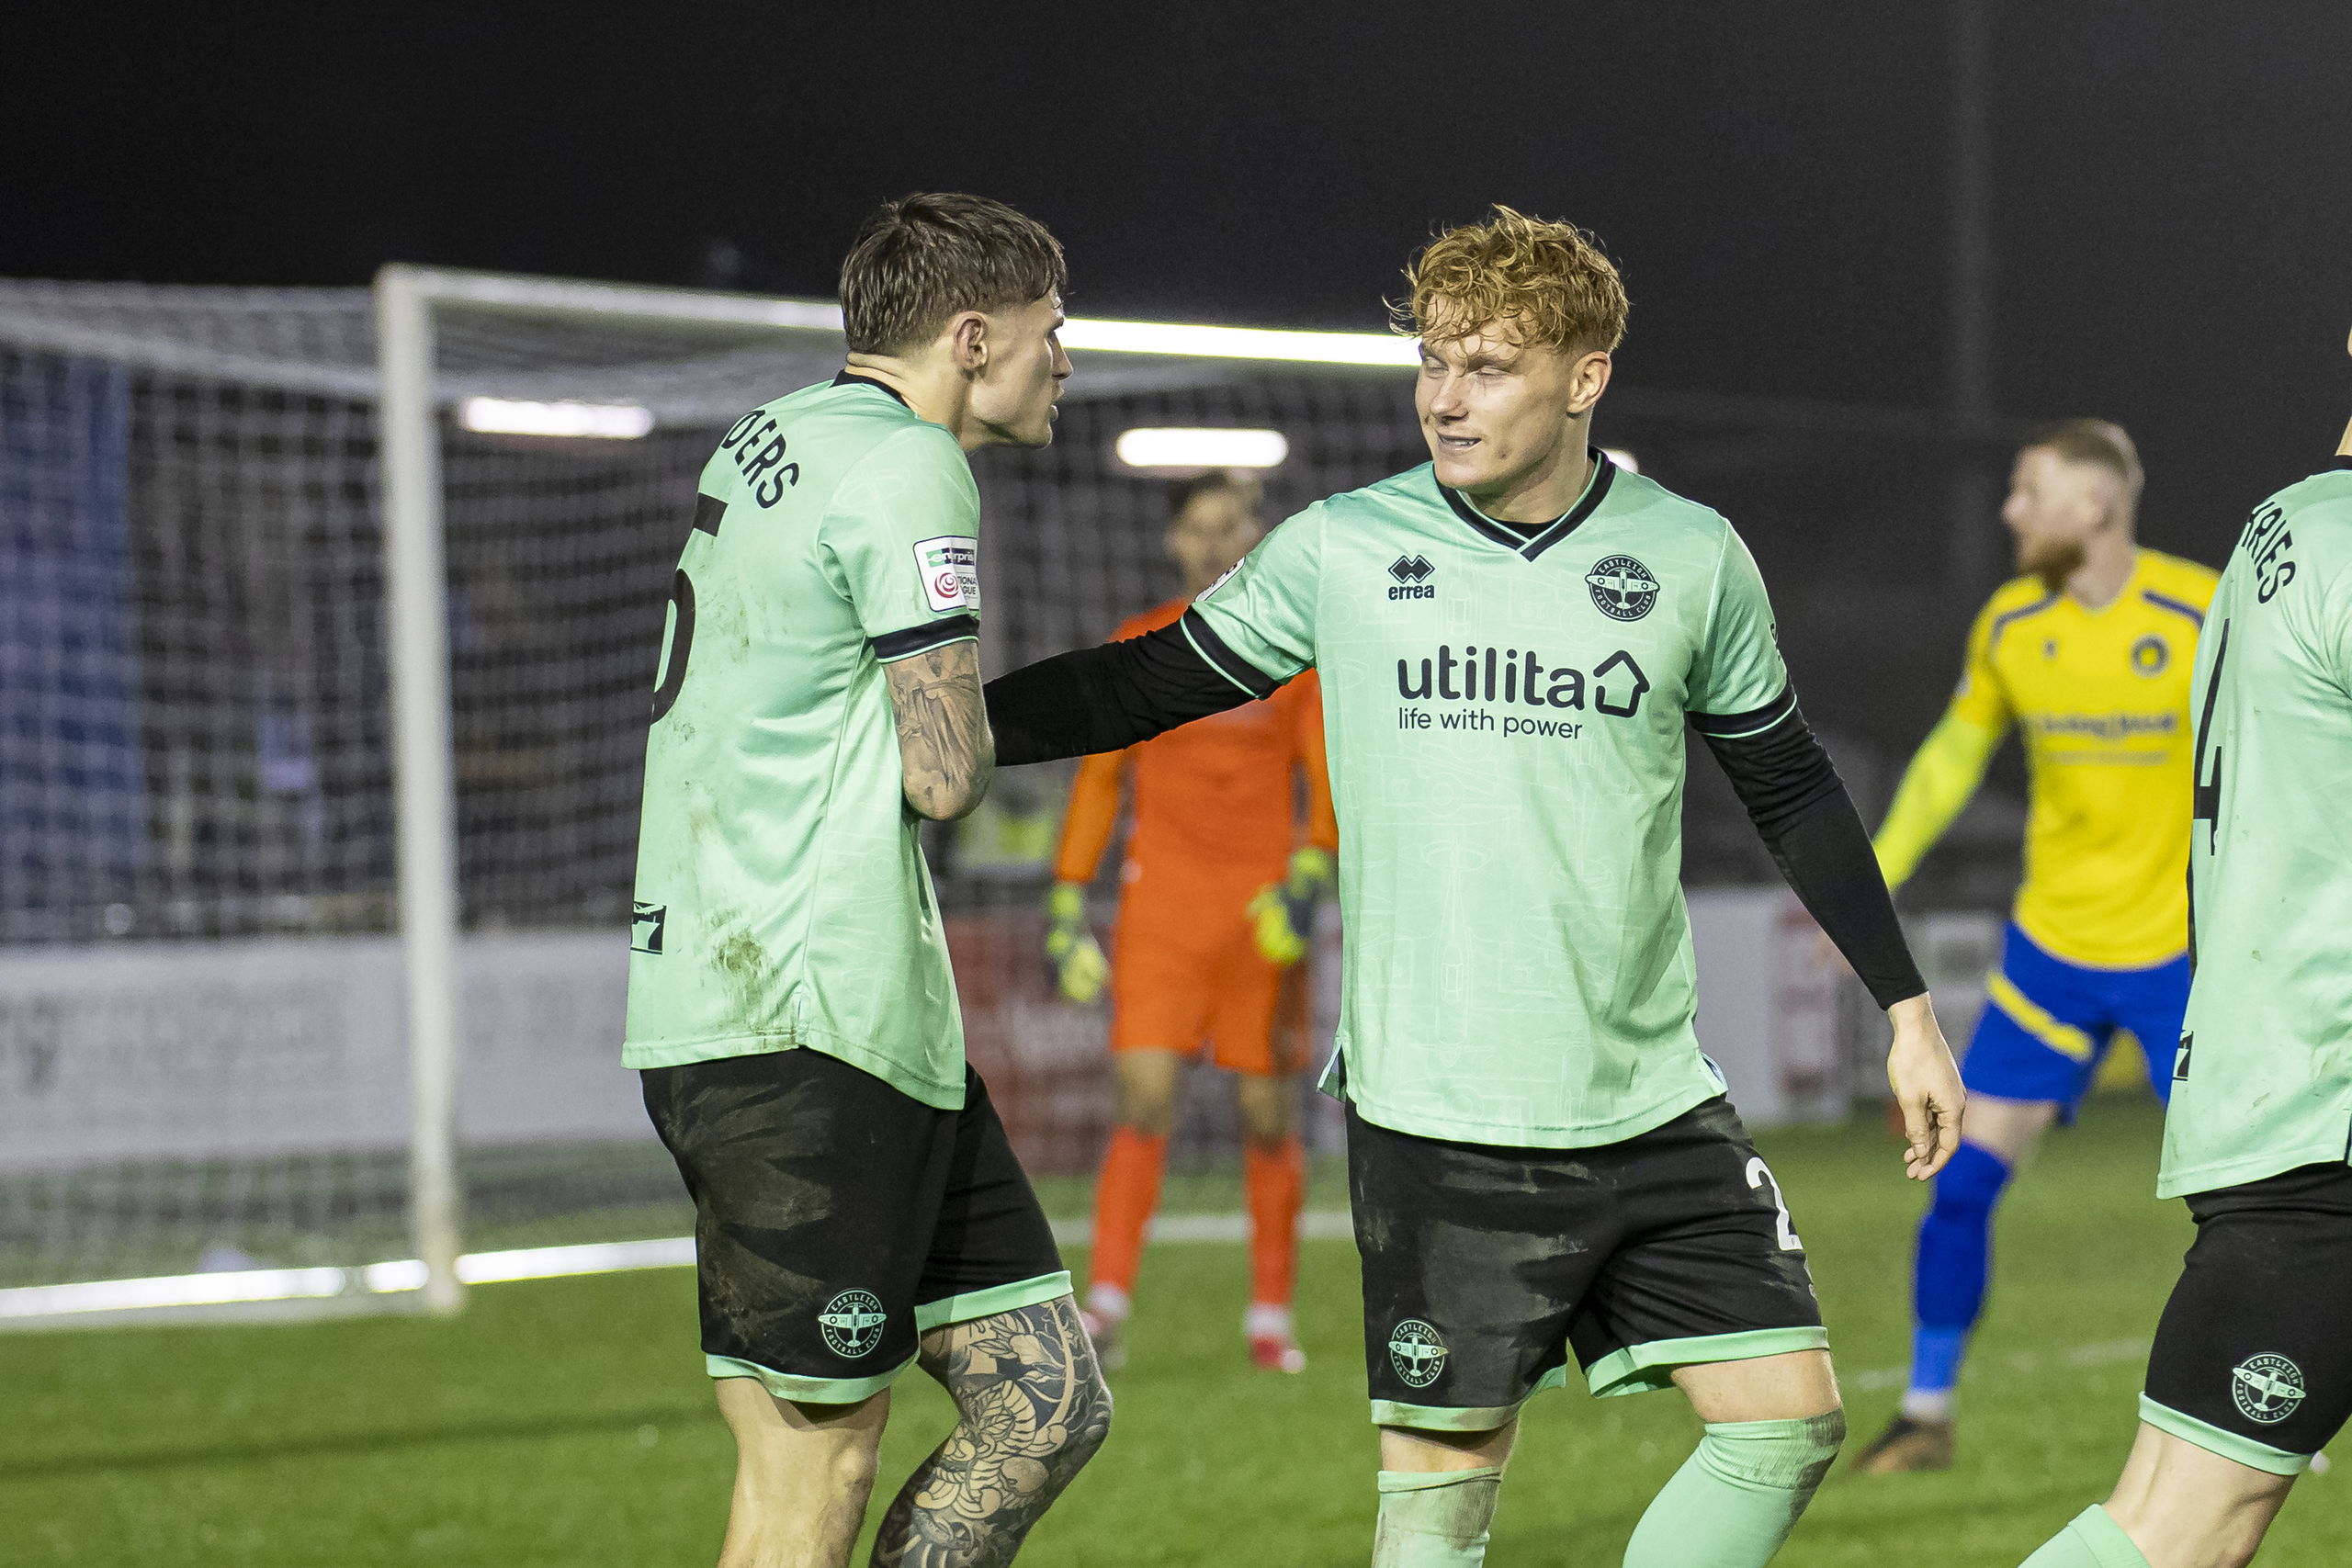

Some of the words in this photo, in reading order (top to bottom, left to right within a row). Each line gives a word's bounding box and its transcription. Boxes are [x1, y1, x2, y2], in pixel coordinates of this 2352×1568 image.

[1599, 559, 1647, 579] EASTLEIGH
[1388, 584, 1435, 600] errea
[1595, 589, 1633, 616] FOOTBALL
[1636, 594, 1651, 613] CLUB
[1397, 645, 1585, 710] utilita
[1398, 707, 1431, 729] life
[1440, 708, 1494, 730] with
[1503, 716, 1582, 739] power
[831, 1294, 878, 1311] EASTLEIGH
[826, 1329, 863, 1354] FOOTBALL
[865, 1328, 880, 1348] CLUB
[1394, 1356, 1424, 1383] FOOTBALL
[1426, 1360, 1440, 1380] CLUB
[2249, 1358, 2299, 1384] EASTLEIGH
